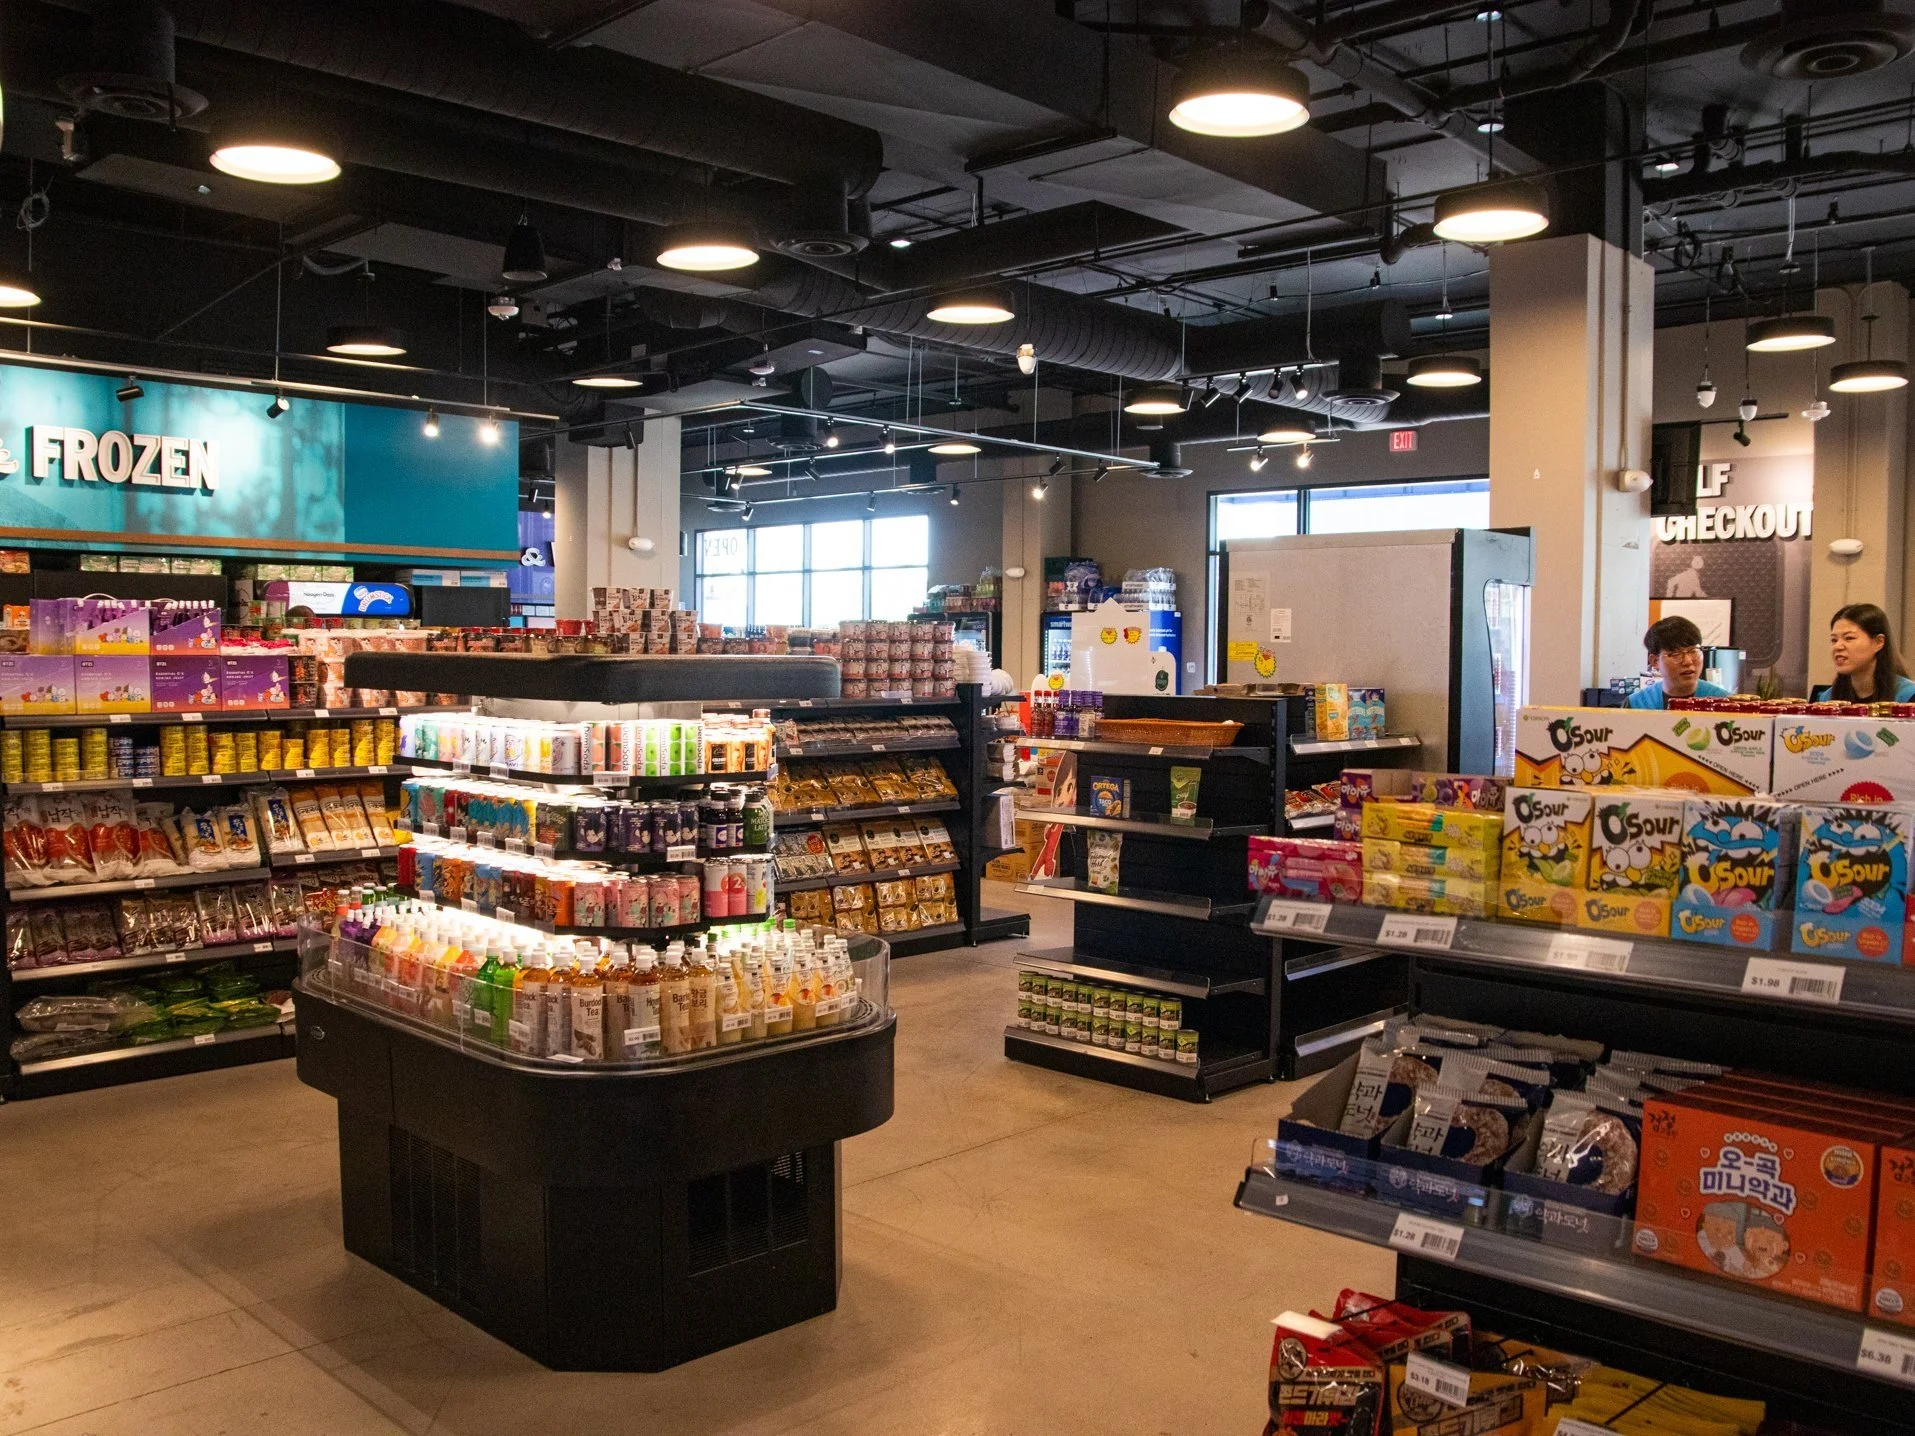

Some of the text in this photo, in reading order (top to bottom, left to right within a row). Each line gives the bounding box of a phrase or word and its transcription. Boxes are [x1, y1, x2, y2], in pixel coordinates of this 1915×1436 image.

[1393, 431, 1413, 450] EXIT
[32, 425, 220, 490] FROZEN
[1697, 462, 1732, 498] LF
[1655, 503, 1814, 542] CHECKOUT
[357, 591, 394, 612] DRUMSTICK
[1712, 761, 1744, 782] OPEN HERE
[1092, 781, 1120, 793] ORTEGA
[1793, 774, 1827, 791] OPEN HERE
[1751, 976, 1780, 988] $1.98
[579, 998, 601, 1008] Burdoc
[1702, 1169, 1794, 1211] 미니약과
